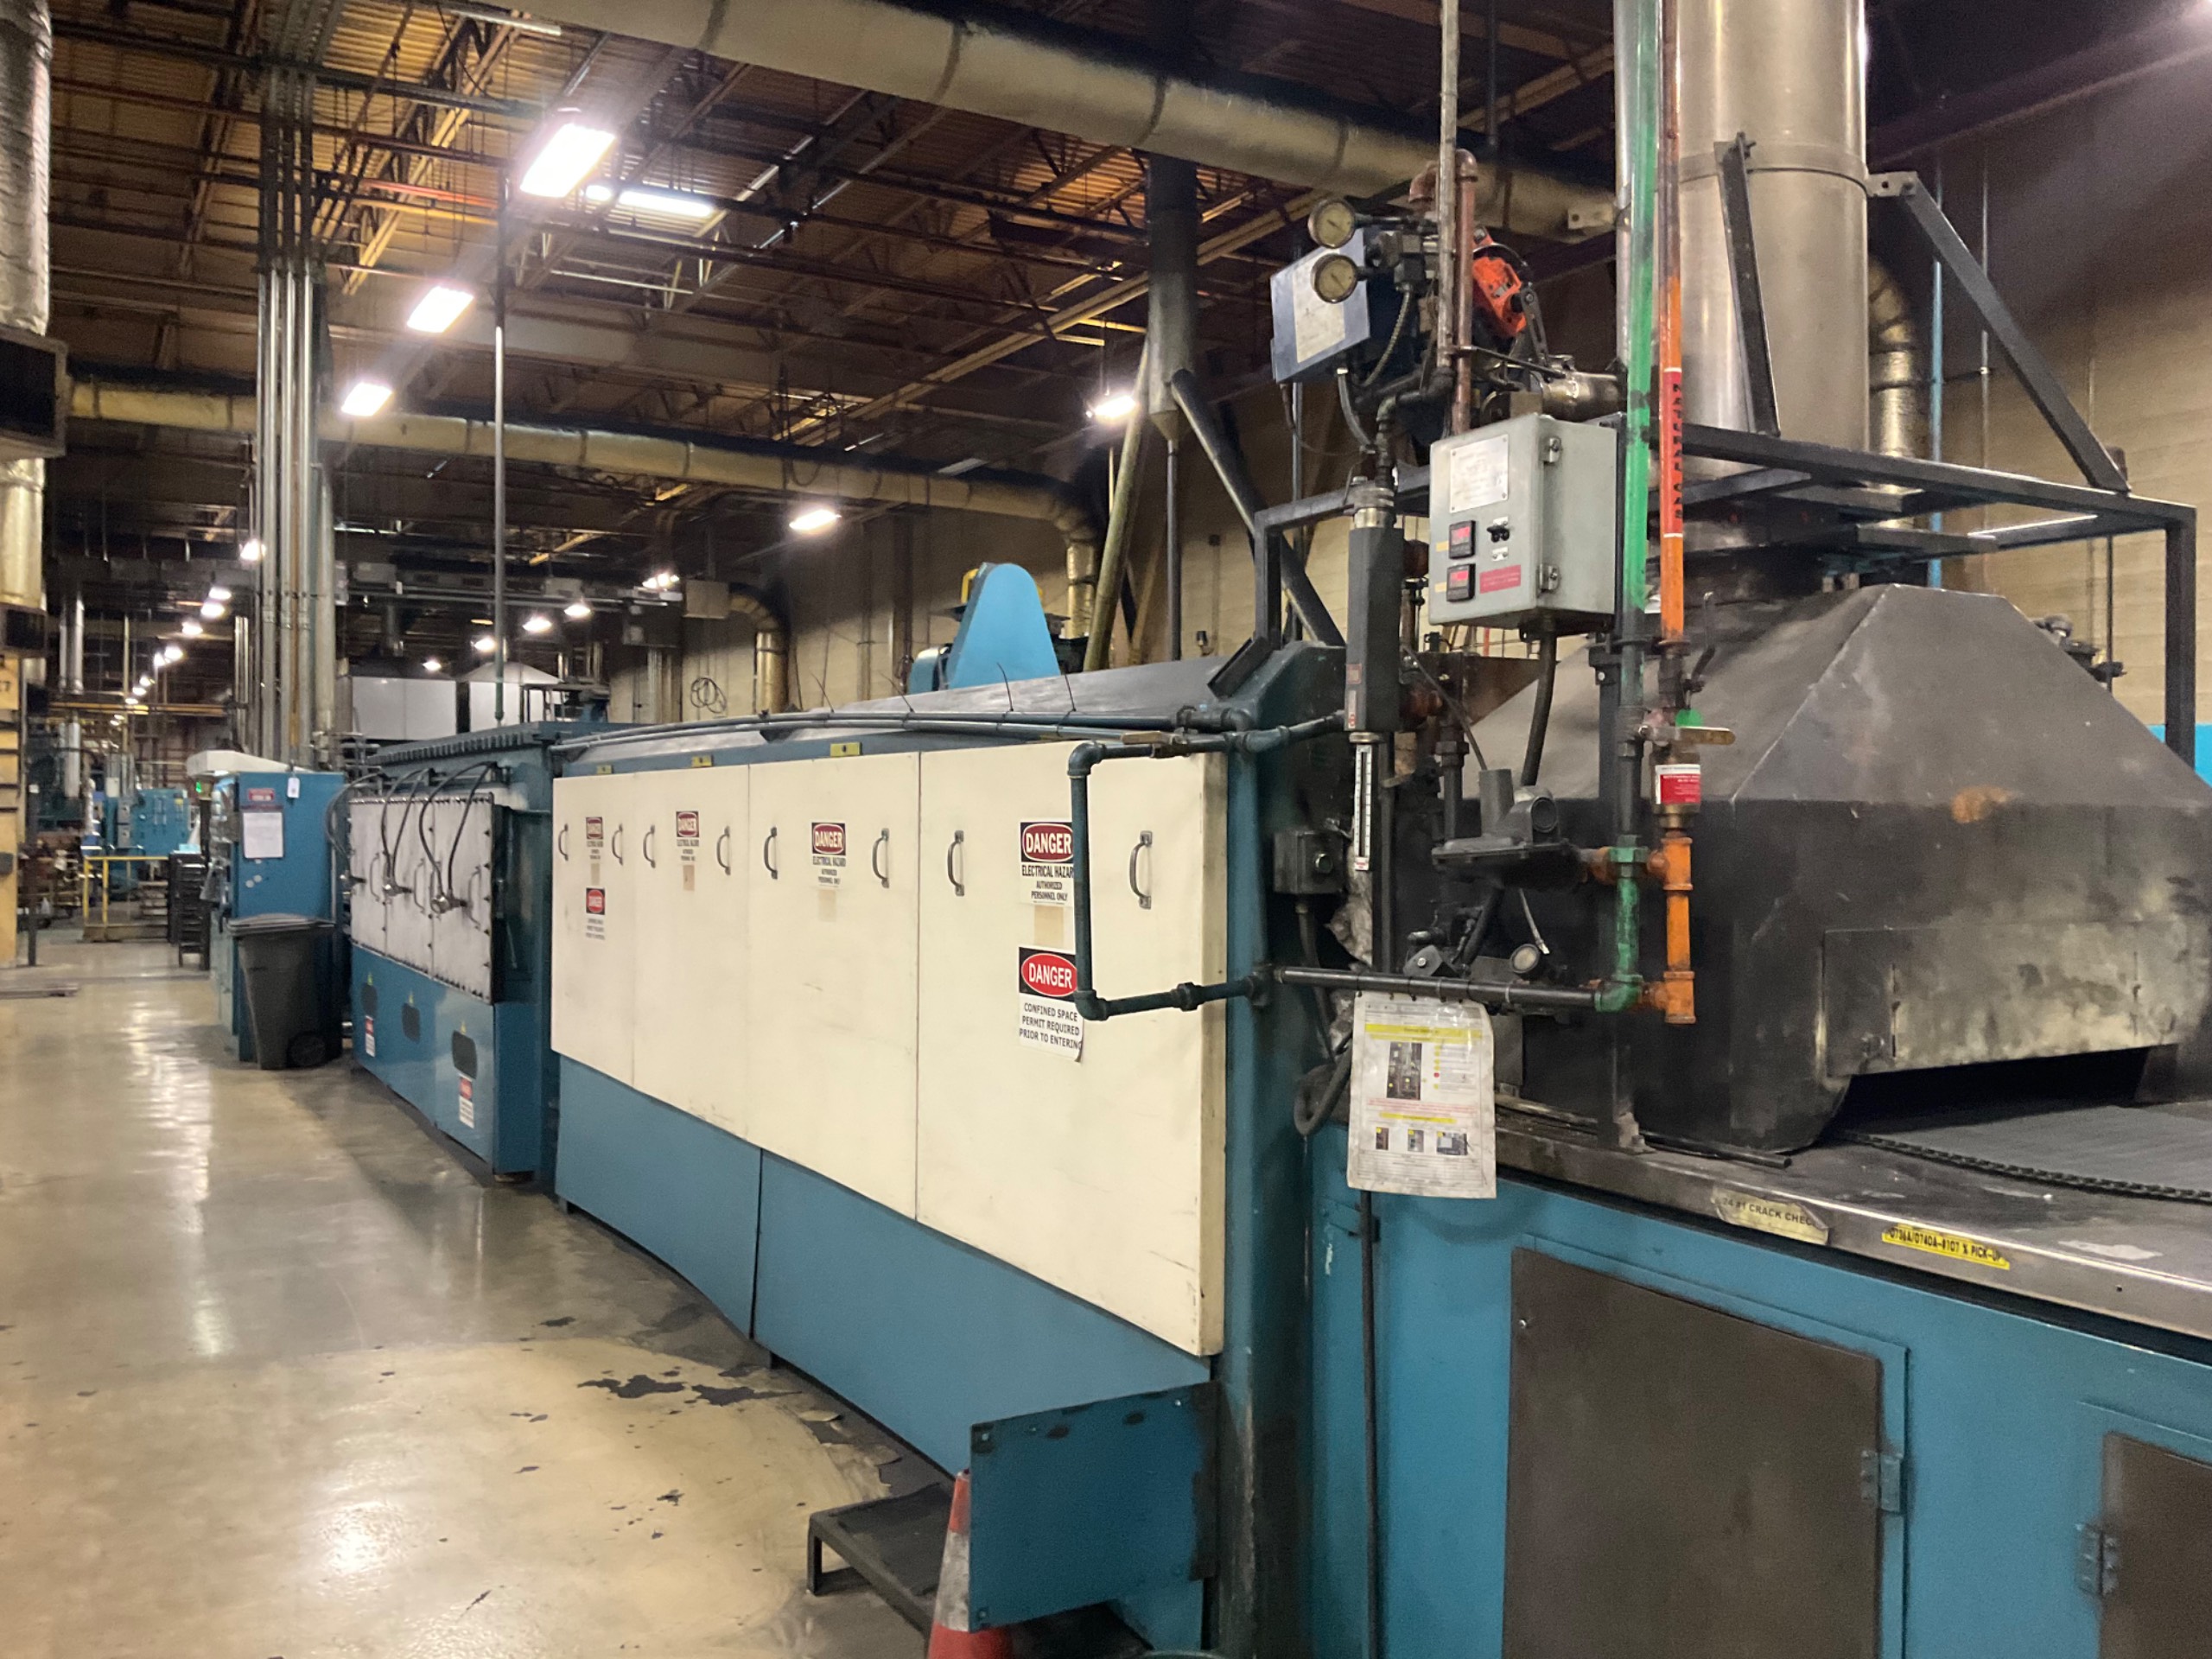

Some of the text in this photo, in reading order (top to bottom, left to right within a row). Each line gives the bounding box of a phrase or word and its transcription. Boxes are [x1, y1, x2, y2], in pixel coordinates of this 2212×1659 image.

[815, 830, 842, 849] DANGER
[1025, 833, 1071, 855] DANGER
[1022, 865, 1074, 879] ELECTRICAL HAZAR
[1028, 963, 1072, 989] DANGER
[1024, 1002, 1077, 1021] CONFINED SPACE
[1020, 1028, 1039, 1041] PRIOR
[1040, 1033, 1048, 1043] TO
[1022, 1015, 1079, 1036] PERMIT REQUIRED
[1749, 1204, 1782, 1219] CRACK
[1785, 1212, 1814, 1226] CHEC
